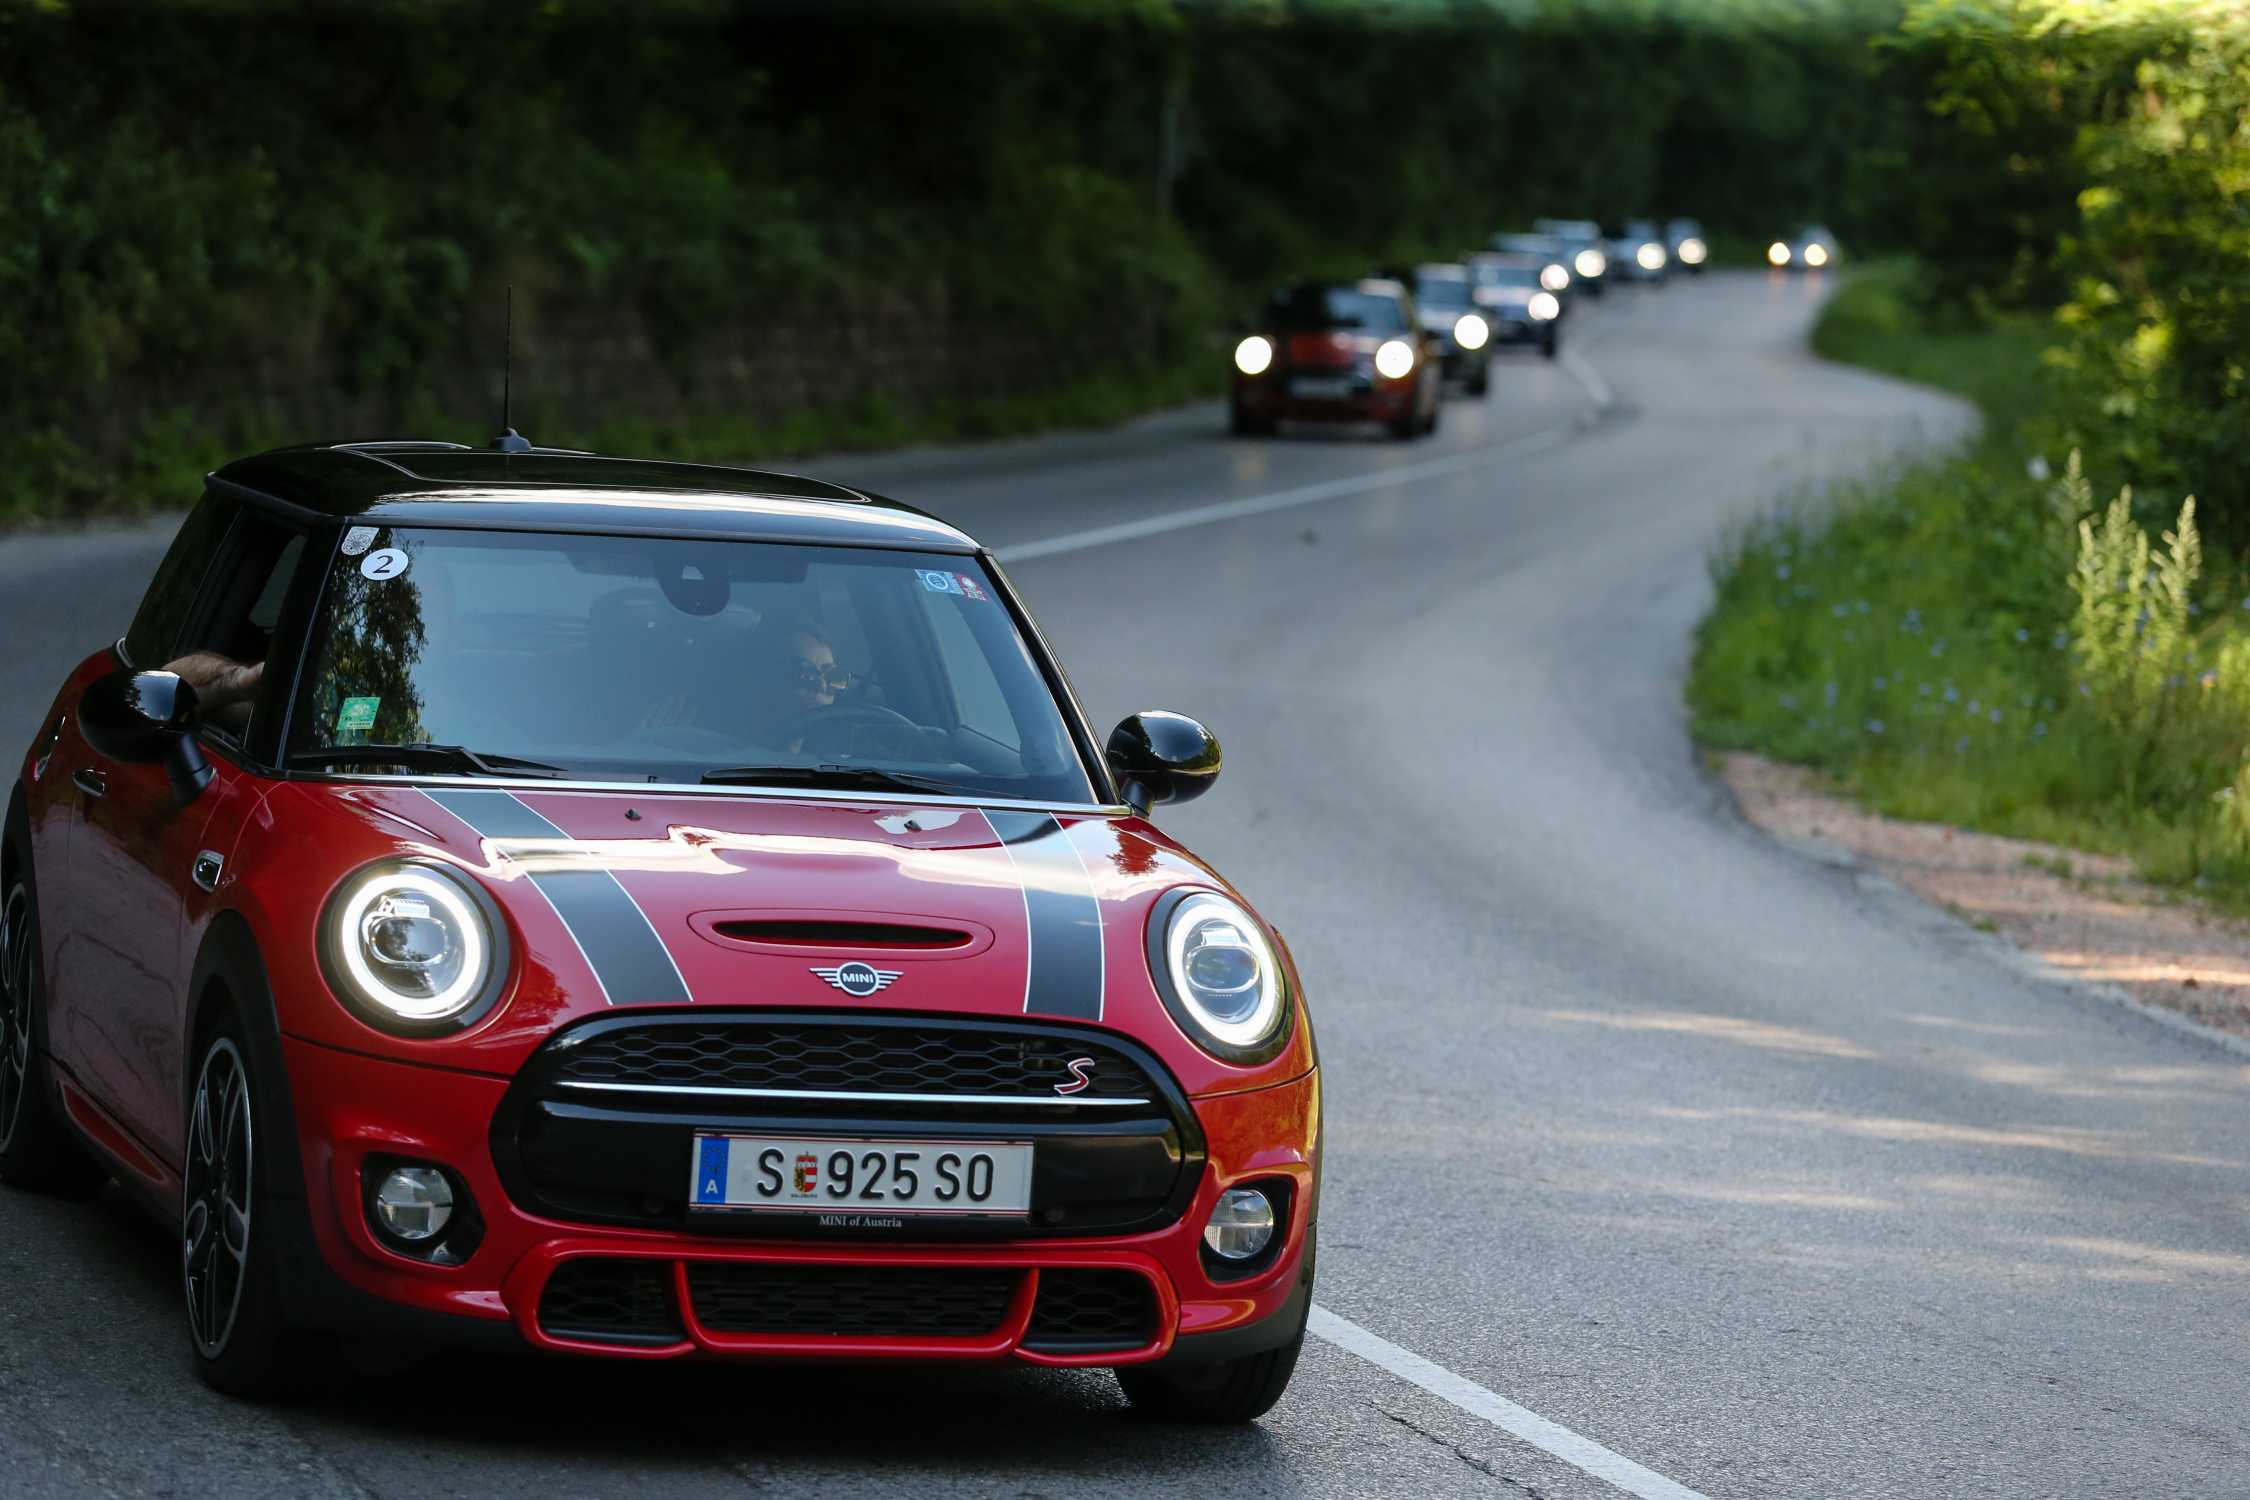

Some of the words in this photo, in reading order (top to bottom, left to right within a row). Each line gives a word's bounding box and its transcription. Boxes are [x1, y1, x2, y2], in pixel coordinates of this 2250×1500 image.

[372, 555, 394, 574] 2
[842, 972, 874, 984] MINI
[1054, 1058, 1095, 1095] S
[756, 1147, 785, 1198] S
[826, 1150, 921, 1200] 925
[934, 1152, 995, 1202] SO
[705, 1179, 719, 1195] A
[819, 1215, 847, 1226] MINI
[849, 1215, 861, 1226] of
[863, 1216, 902, 1228] Austria
